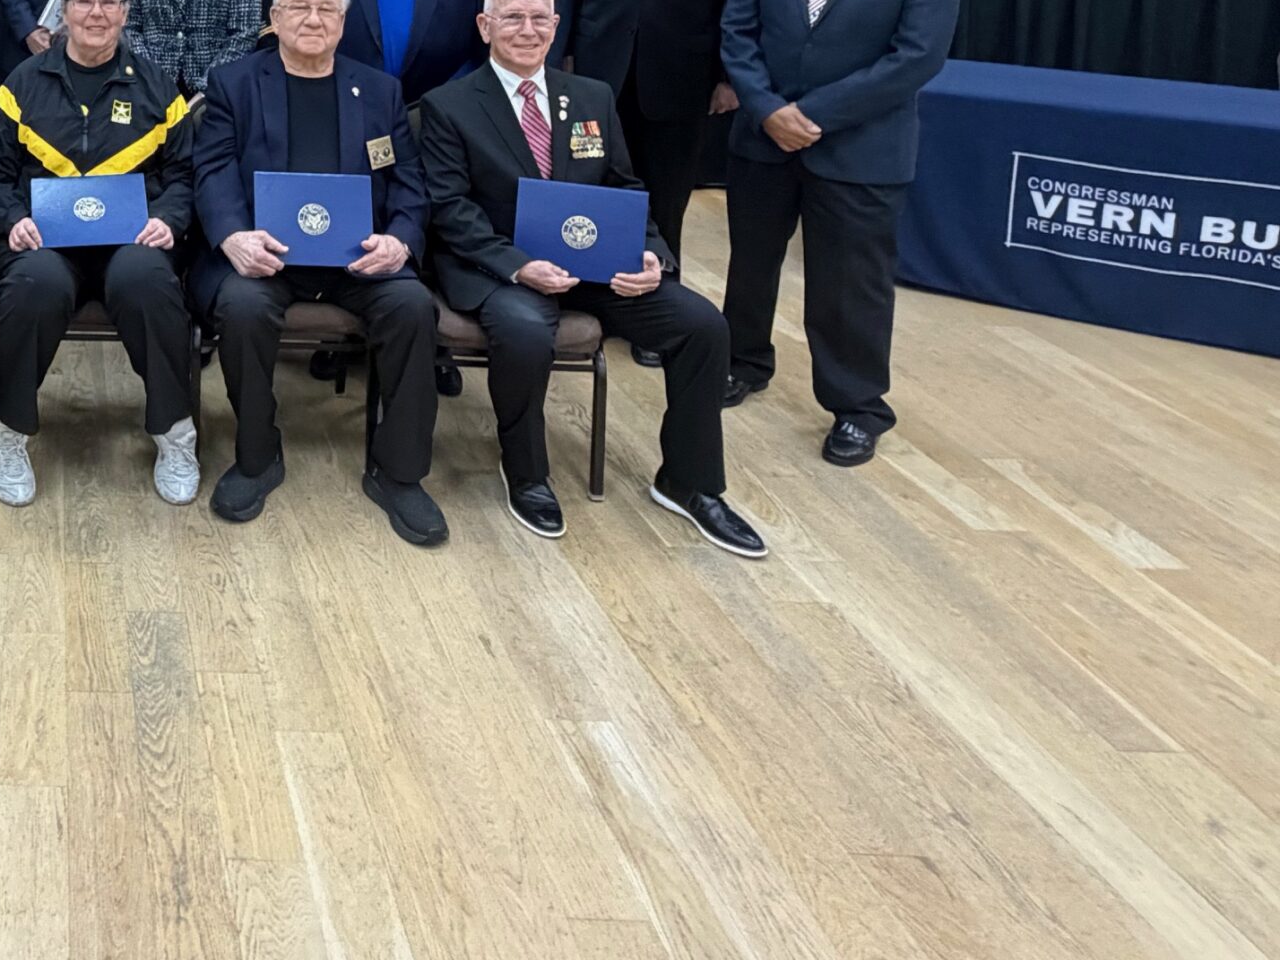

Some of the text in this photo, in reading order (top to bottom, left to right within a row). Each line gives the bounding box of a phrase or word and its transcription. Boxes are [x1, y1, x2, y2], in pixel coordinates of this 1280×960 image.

[1027, 176, 1175, 210] CONGRESSMAN
[1030, 190, 1176, 239] VERN
[1025, 217, 1280, 270] REPRESENTING FLORIDA'S
